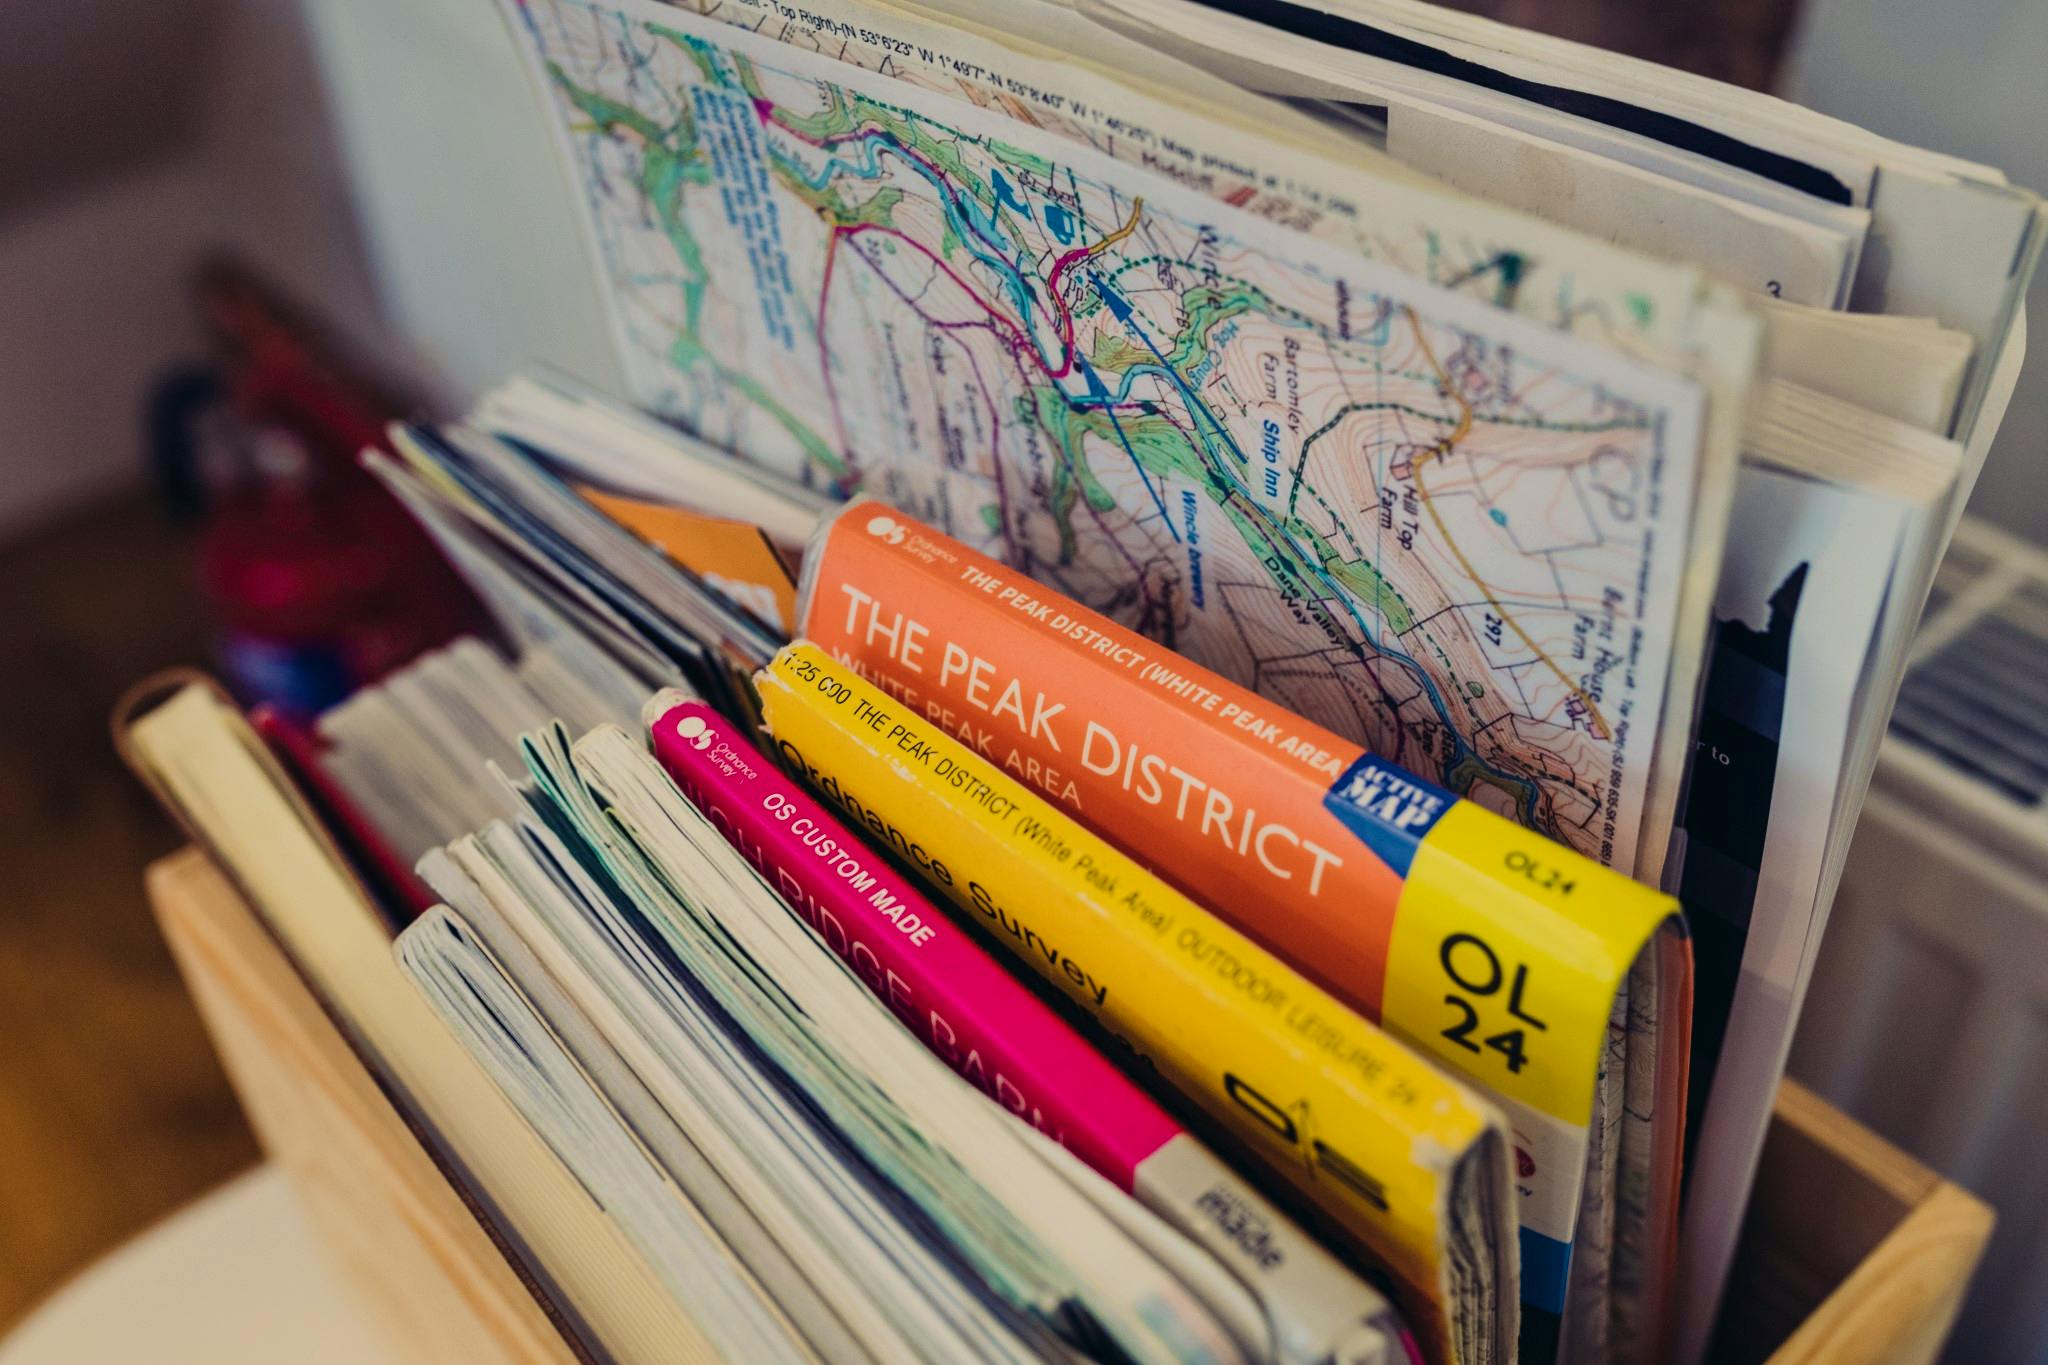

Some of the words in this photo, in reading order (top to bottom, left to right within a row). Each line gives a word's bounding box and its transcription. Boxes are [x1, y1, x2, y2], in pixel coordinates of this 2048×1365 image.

[917, 47, 933, 64] W
[1263, 352, 1280, 399] Farm
[1261, 419, 1280, 464] Ship
[1264, 467, 1281, 498] Inn
[1402, 485, 1418, 515] Hill
[1380, 487, 1398, 530] Farm
[1398, 523, 1419, 551] Top
[1264, 556, 1303, 599] Dane
[1305, 599, 1343, 645] Valley
[1279, 589, 1311, 627] Way
[1484, 613, 1503, 645] 297
[960, 565, 1003, 594] THE
[998, 586, 1055, 622] PEAK
[1050, 613, 1146, 670] DISTRICT
[1139, 662, 1223, 712] (WHITE
[1218, 702, 1284, 745] PEAK
[829, 646, 917, 710] WHITE
[926, 701, 995, 757] PEAK
[1005, 748, 1082, 810] AREA
[841, 583, 930, 674] THE
[940, 642, 1066, 752] PEAK
[1081, 719, 1343, 896] DISTRICT
[706, 751, 736, 777] Survey
[715, 743, 757, 781] Ordnance
[1712, 746, 1730, 765] to
[1340, 775, 1431, 830] MAP
[1357, 764, 1445, 814] ACTIVE
[763, 793, 797, 821] OS
[791, 818, 877, 894] CUSTOM
[868, 889, 936, 948] MADE
[778, 739, 955, 887] Ordnance
[969, 881, 1107, 1006] Survey
[853, 699, 891, 732] THE
[887, 724, 939, 767] PEAK
[934, 758, 1020, 821] DISTRICT
[1013, 815, 1072, 861] (White
[1074, 854, 1116, 897] Peak
[1122, 892, 1175, 937] Area)
[1177, 927, 1288, 1012] OUTDOOR
[1286, 1003, 1387, 1078] LEISURE
[1504, 850, 1578, 895] OL24
[1440, 932, 1547, 1032] OL
[1440, 995, 1529, 1075] 24
